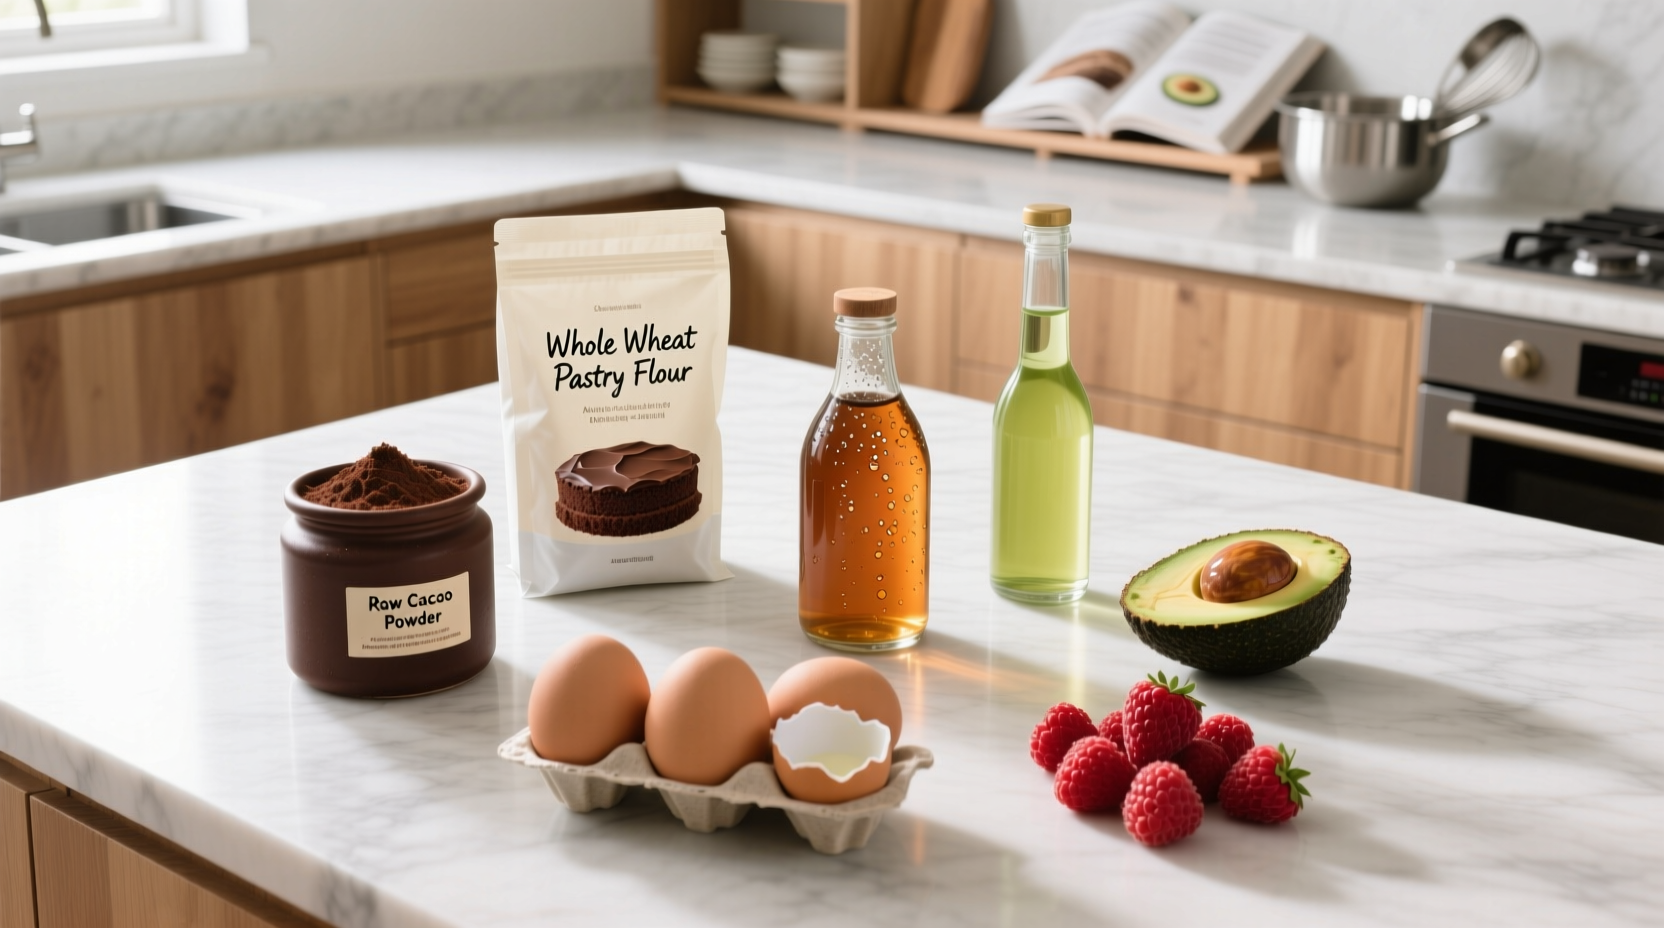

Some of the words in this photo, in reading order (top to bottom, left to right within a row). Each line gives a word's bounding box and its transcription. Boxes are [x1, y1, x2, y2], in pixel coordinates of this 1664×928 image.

[547, 327, 617, 358] Whole
[624, 323, 698, 354] Wheat
[554, 362, 624, 398] Pastry
[634, 357, 693, 386] Flour
[369, 595, 402, 612] Raw
[385, 610, 442, 629] Powder
